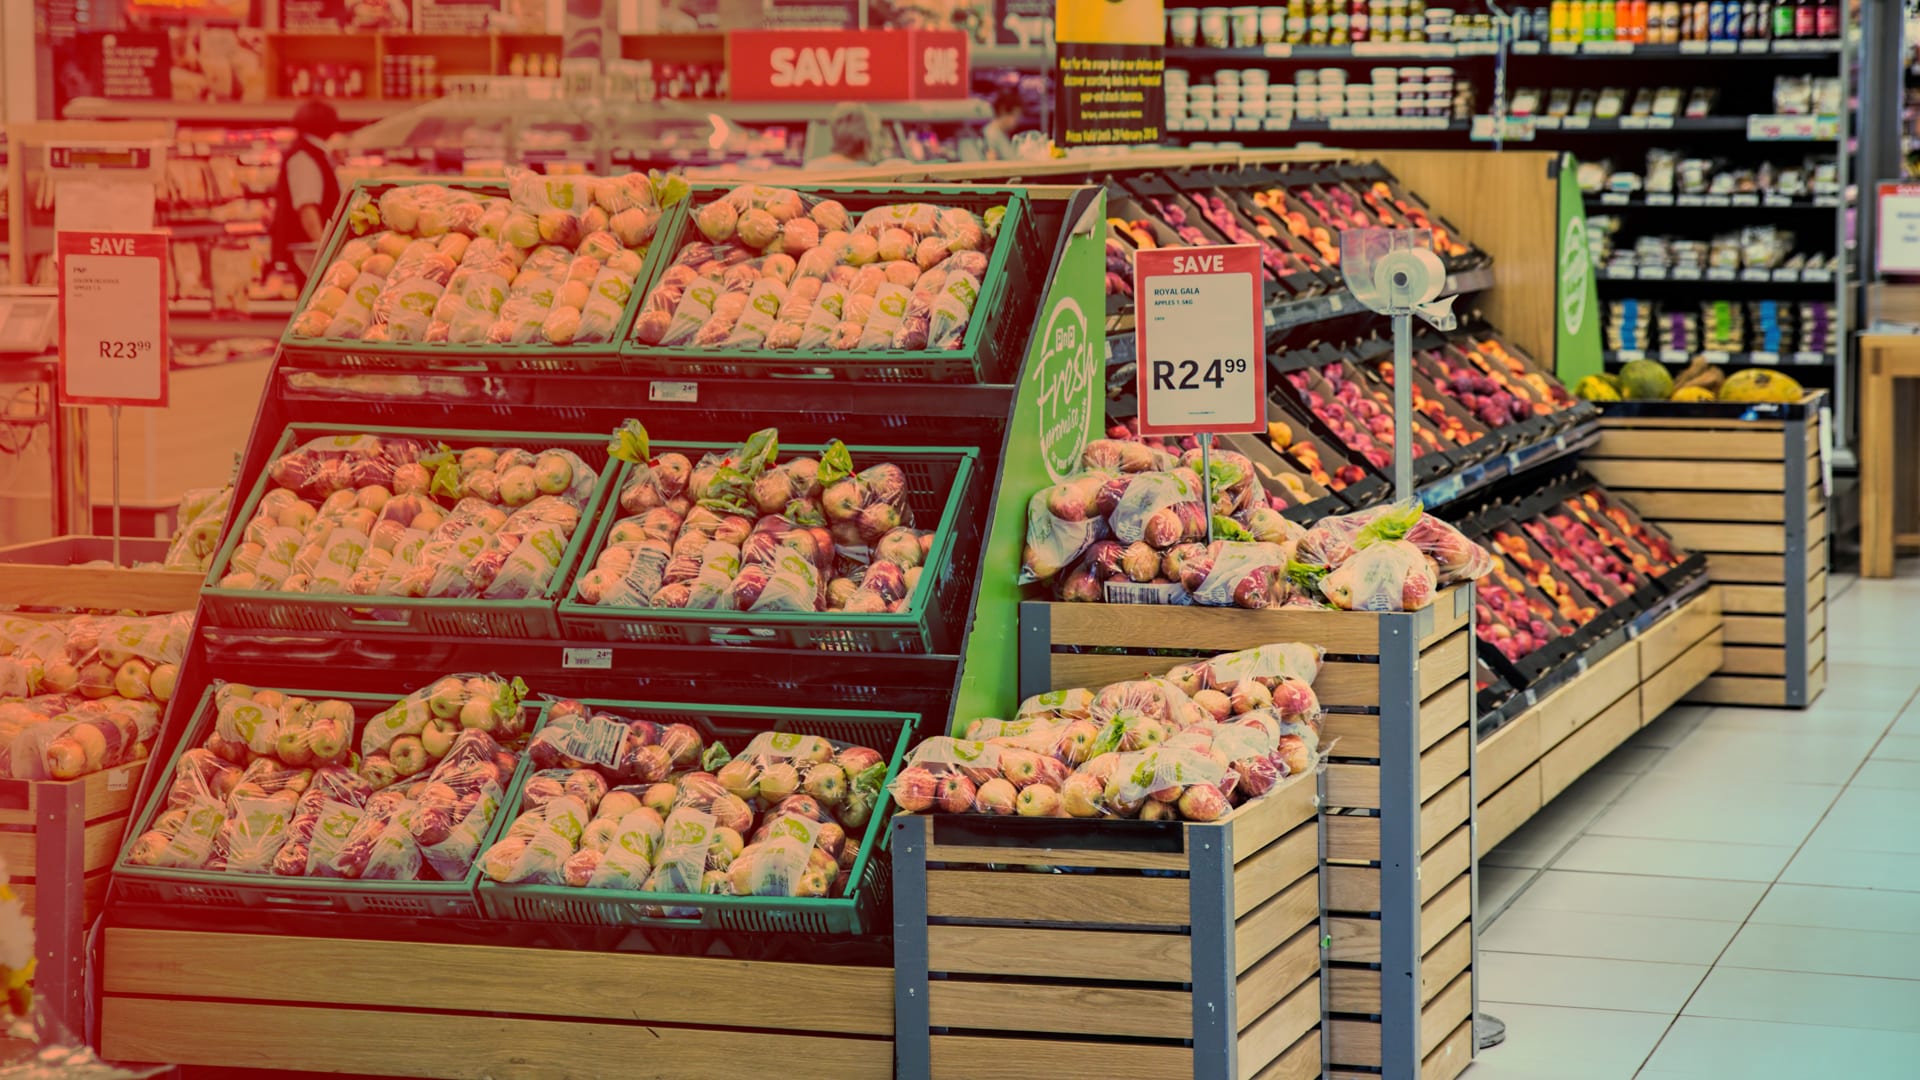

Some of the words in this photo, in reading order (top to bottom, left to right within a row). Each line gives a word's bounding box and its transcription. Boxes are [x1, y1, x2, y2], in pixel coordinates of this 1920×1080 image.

[770, 47, 870, 86] SAVE
[90, 237, 135, 256] SAVE
[1173, 254, 1224, 274] SAVE
[1154, 288, 1178, 296] ROYAL
[1180, 287, 1200, 295] GALA
[1033, 316, 1098, 420] Fresh
